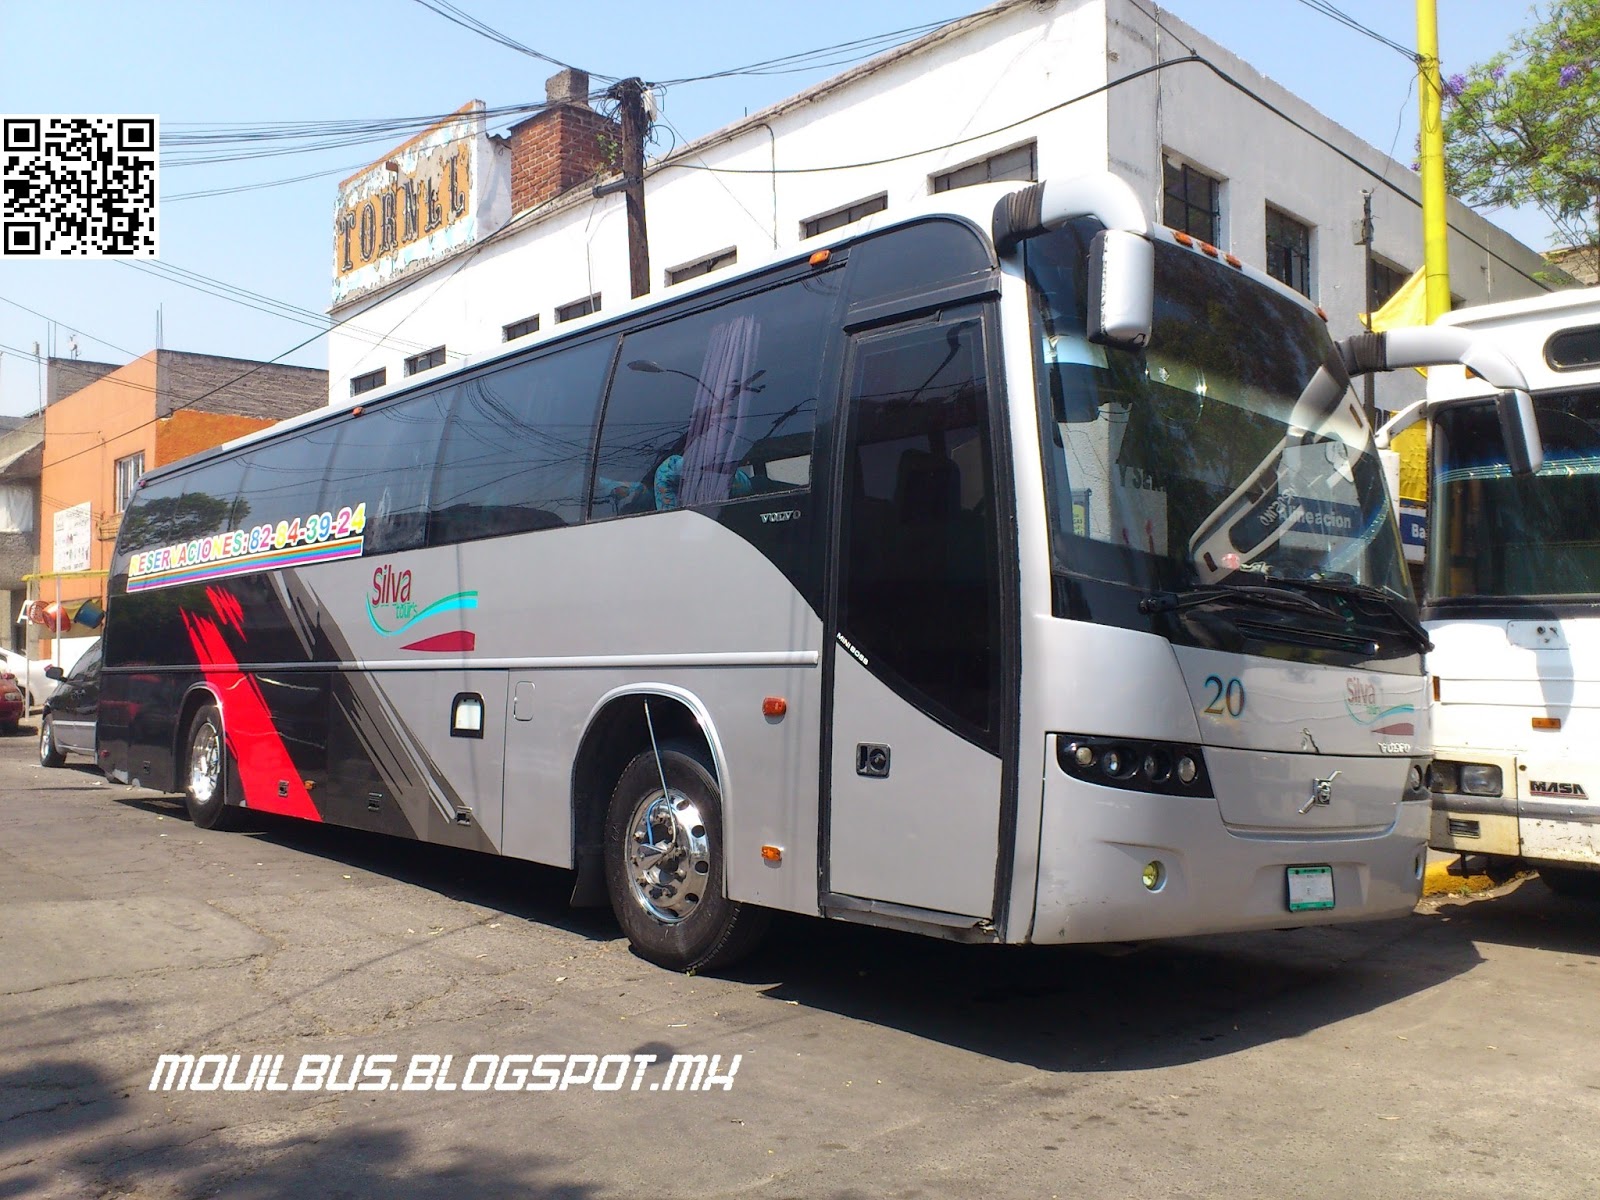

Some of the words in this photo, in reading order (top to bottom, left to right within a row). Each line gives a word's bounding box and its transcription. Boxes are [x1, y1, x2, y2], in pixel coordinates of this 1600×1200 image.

[760, 510, 801, 523] VOLVO
[1411, 523, 1428, 539] Ba
[128, 529, 249, 578] RESERVACIONES:
[249, 502, 367, 552] 82-84-39-24
[372, 564, 412, 606] Silva
[1204, 674, 1246, 719] 20
[1346, 677, 1377, 706] Silva
[1529, 780, 1586, 795] MASA
